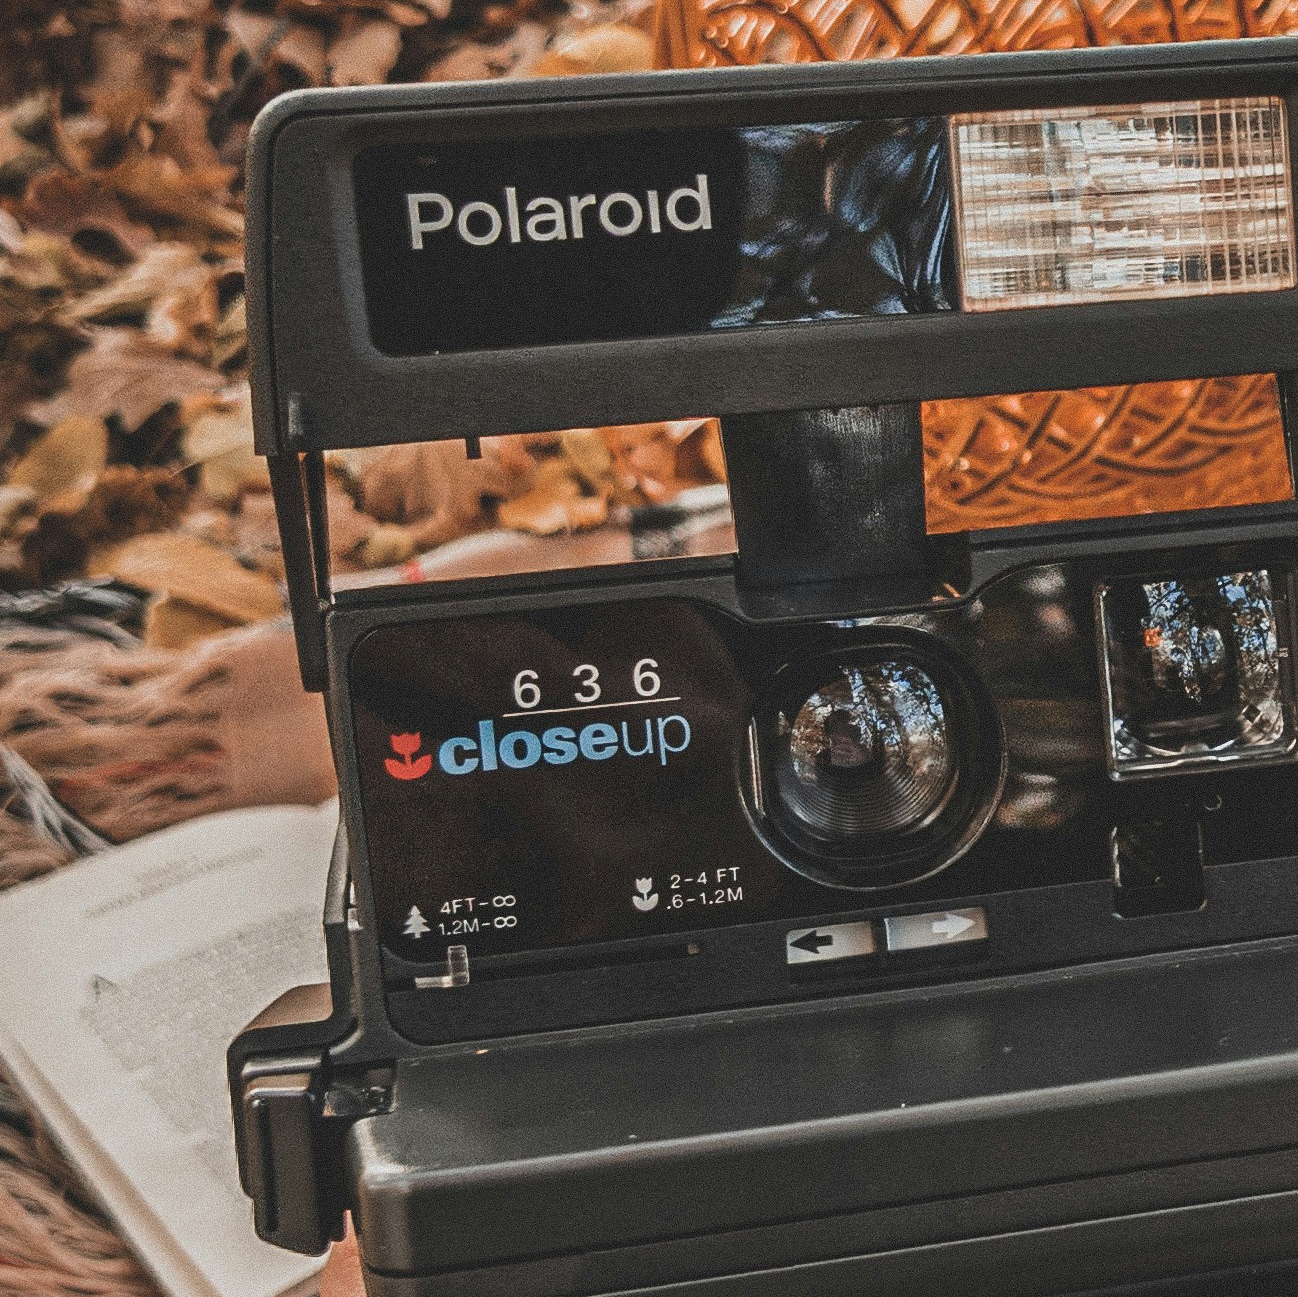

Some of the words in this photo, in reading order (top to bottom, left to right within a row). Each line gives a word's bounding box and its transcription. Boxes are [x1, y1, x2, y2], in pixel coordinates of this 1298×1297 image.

[407, 174, 712, 250] Polaroid
[439, 714, 691, 775] closeup
[716, 866, 740, 883] FT
[666, 886, 743, 910] .6-1.2M
